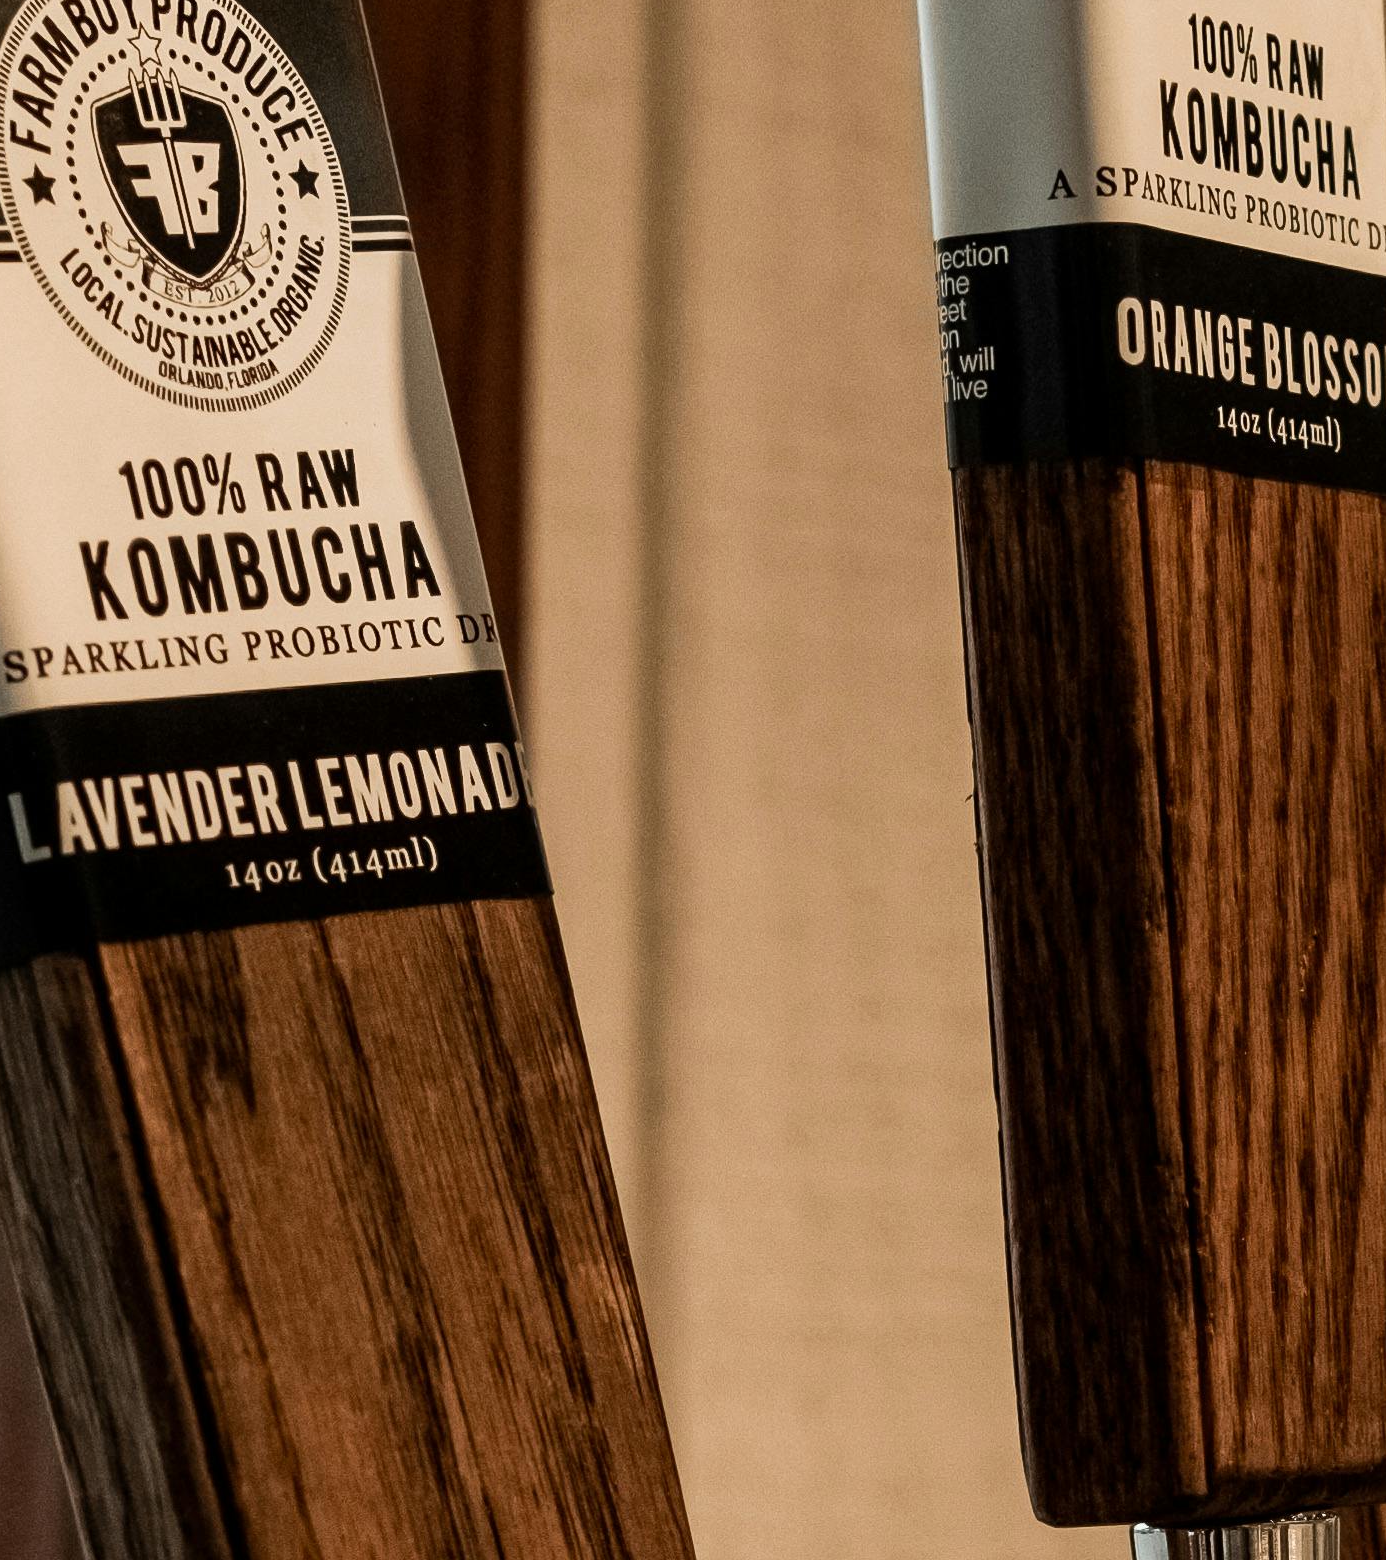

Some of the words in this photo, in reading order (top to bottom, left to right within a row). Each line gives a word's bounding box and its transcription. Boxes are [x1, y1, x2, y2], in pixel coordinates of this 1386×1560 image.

[1187, 12, 1259, 85] 100%
[1265, 32, 1324, 101] RAW
[1159, 78, 1362, 201] KOMBUCHA
[1047, 168, 1078, 200] A
[1095, 165, 1238, 221] SPARKLING
[1244, 193, 1361, 247] PROBIOTIC
[207, 279, 241, 304] 2012
[940, 271, 970, 298] the
[228, 357, 281, 391] FLORIDA
[959, 345, 996, 374] will
[1117, 296, 1256, 387] ORANGE
[952, 375, 988, 402] live
[1217, 405, 1261, 438] 14oz
[1267, 406, 1342, 454] (414ml)
[117, 451, 247, 521] 100%
[254, 448, 360, 512] RAW
[78, 519, 442, 622] KOMBUCHA
[2, 632, 230, 685] SPARKLING
[241, 615, 446, 662] PROBIOTIC
[7, 762, 289, 865] LAVENDER
[224, 858, 303, 893] 14oz
[312, 835, 439, 885] (414ml)
